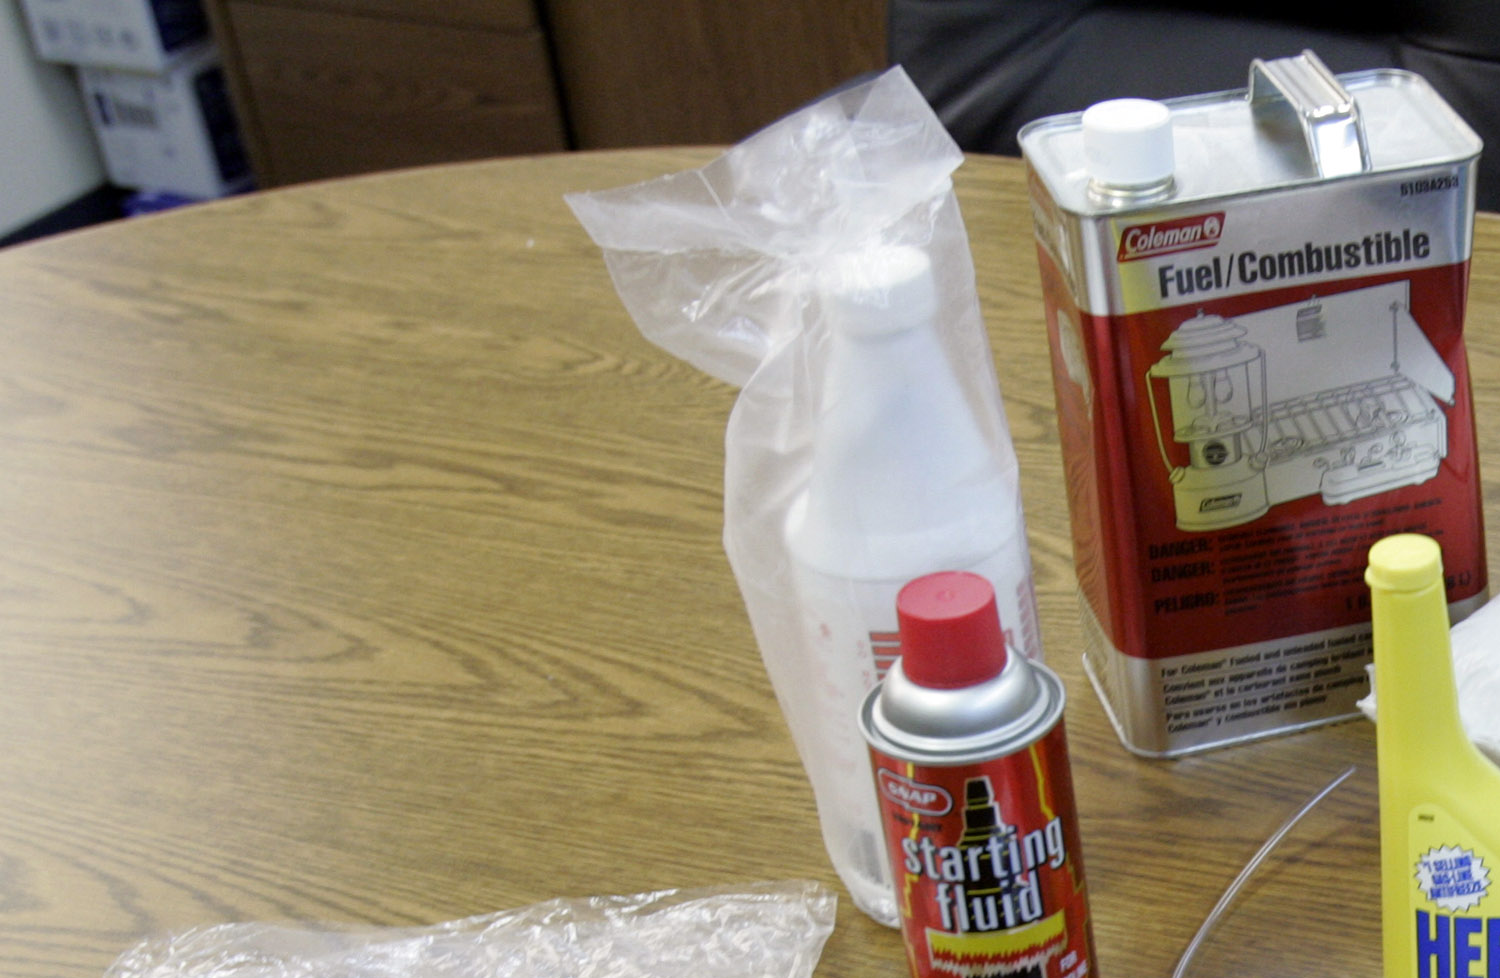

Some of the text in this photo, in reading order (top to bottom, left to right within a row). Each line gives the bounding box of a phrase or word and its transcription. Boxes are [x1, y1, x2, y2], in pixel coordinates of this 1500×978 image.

[1124, 226, 1202, 252] Coleman
[1158, 228, 1431, 299] Fuel/Combustible
[887, 780, 938, 805] SNAP
[902, 816, 1066, 882] starting
[935, 870, 1044, 932] fluid
